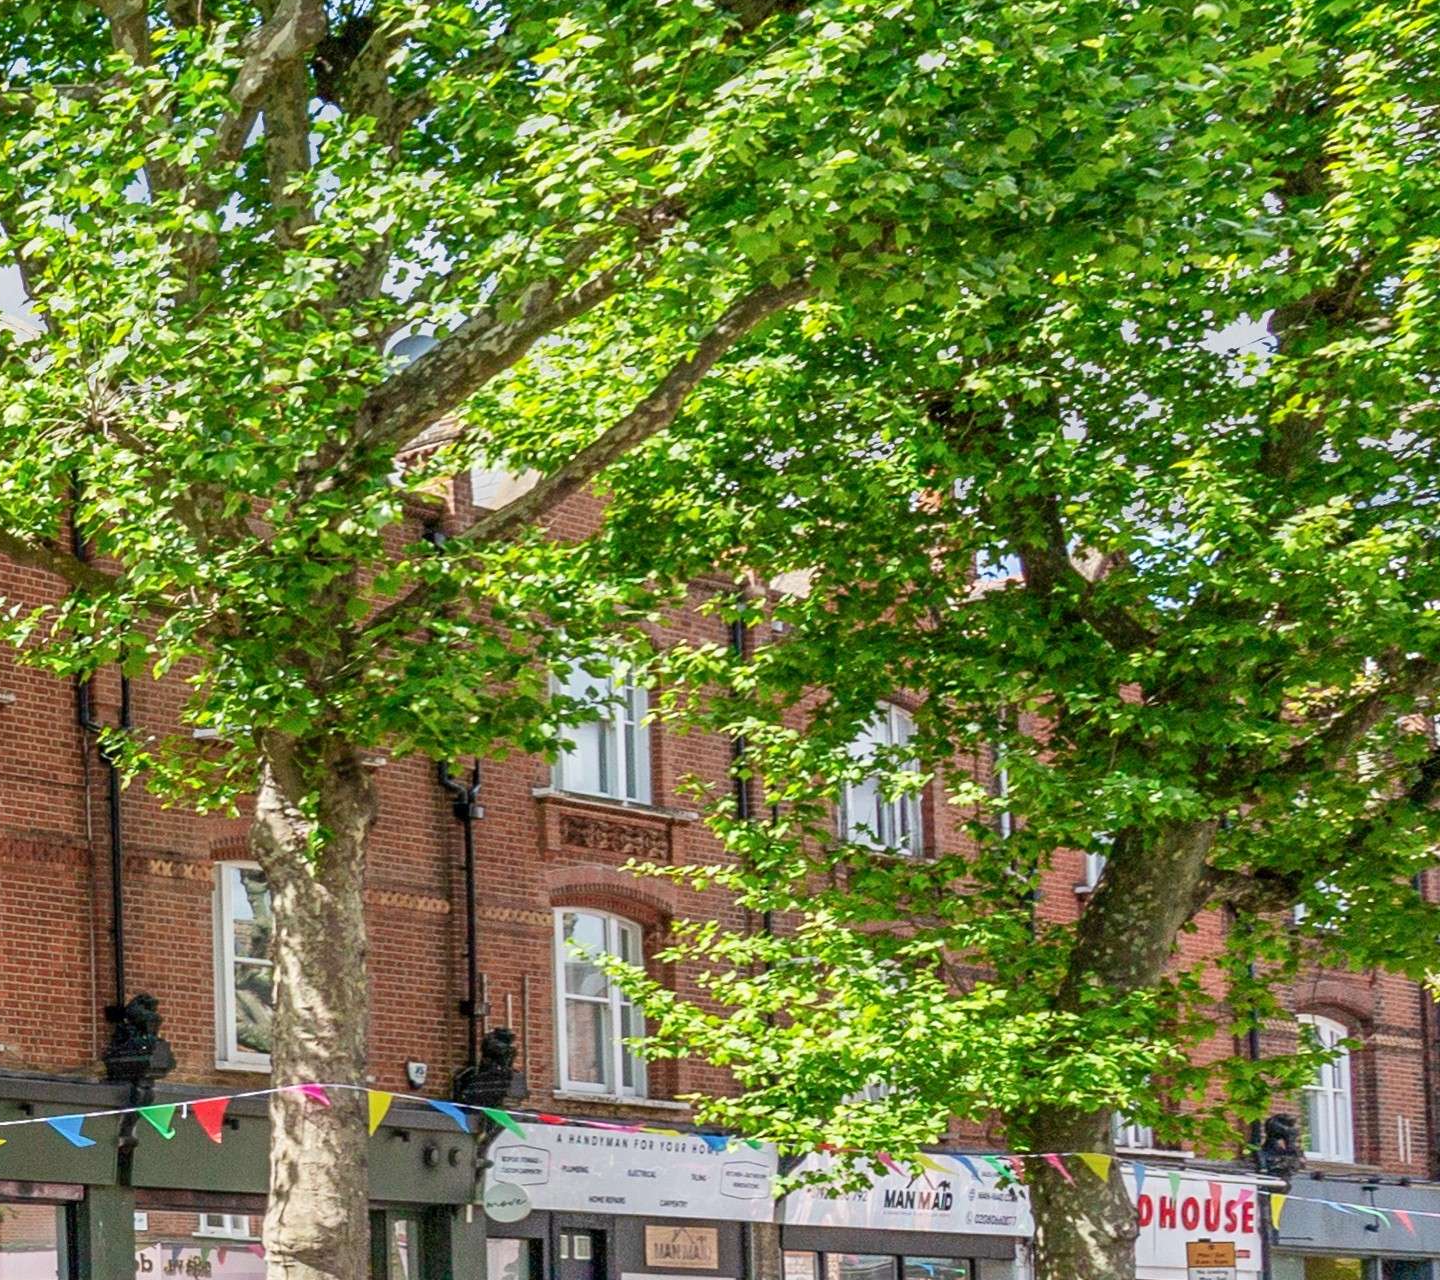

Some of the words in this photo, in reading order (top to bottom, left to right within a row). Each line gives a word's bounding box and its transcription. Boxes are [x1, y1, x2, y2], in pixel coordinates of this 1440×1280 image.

[568, 1135, 628, 1148] HANDYMAN
[633, 1139, 654, 1151] FOR
[660, 1141, 686, 1153] YOUR
[884, 1189, 917, 1209] MAN
[918, 1190, 953, 1211] MAID
